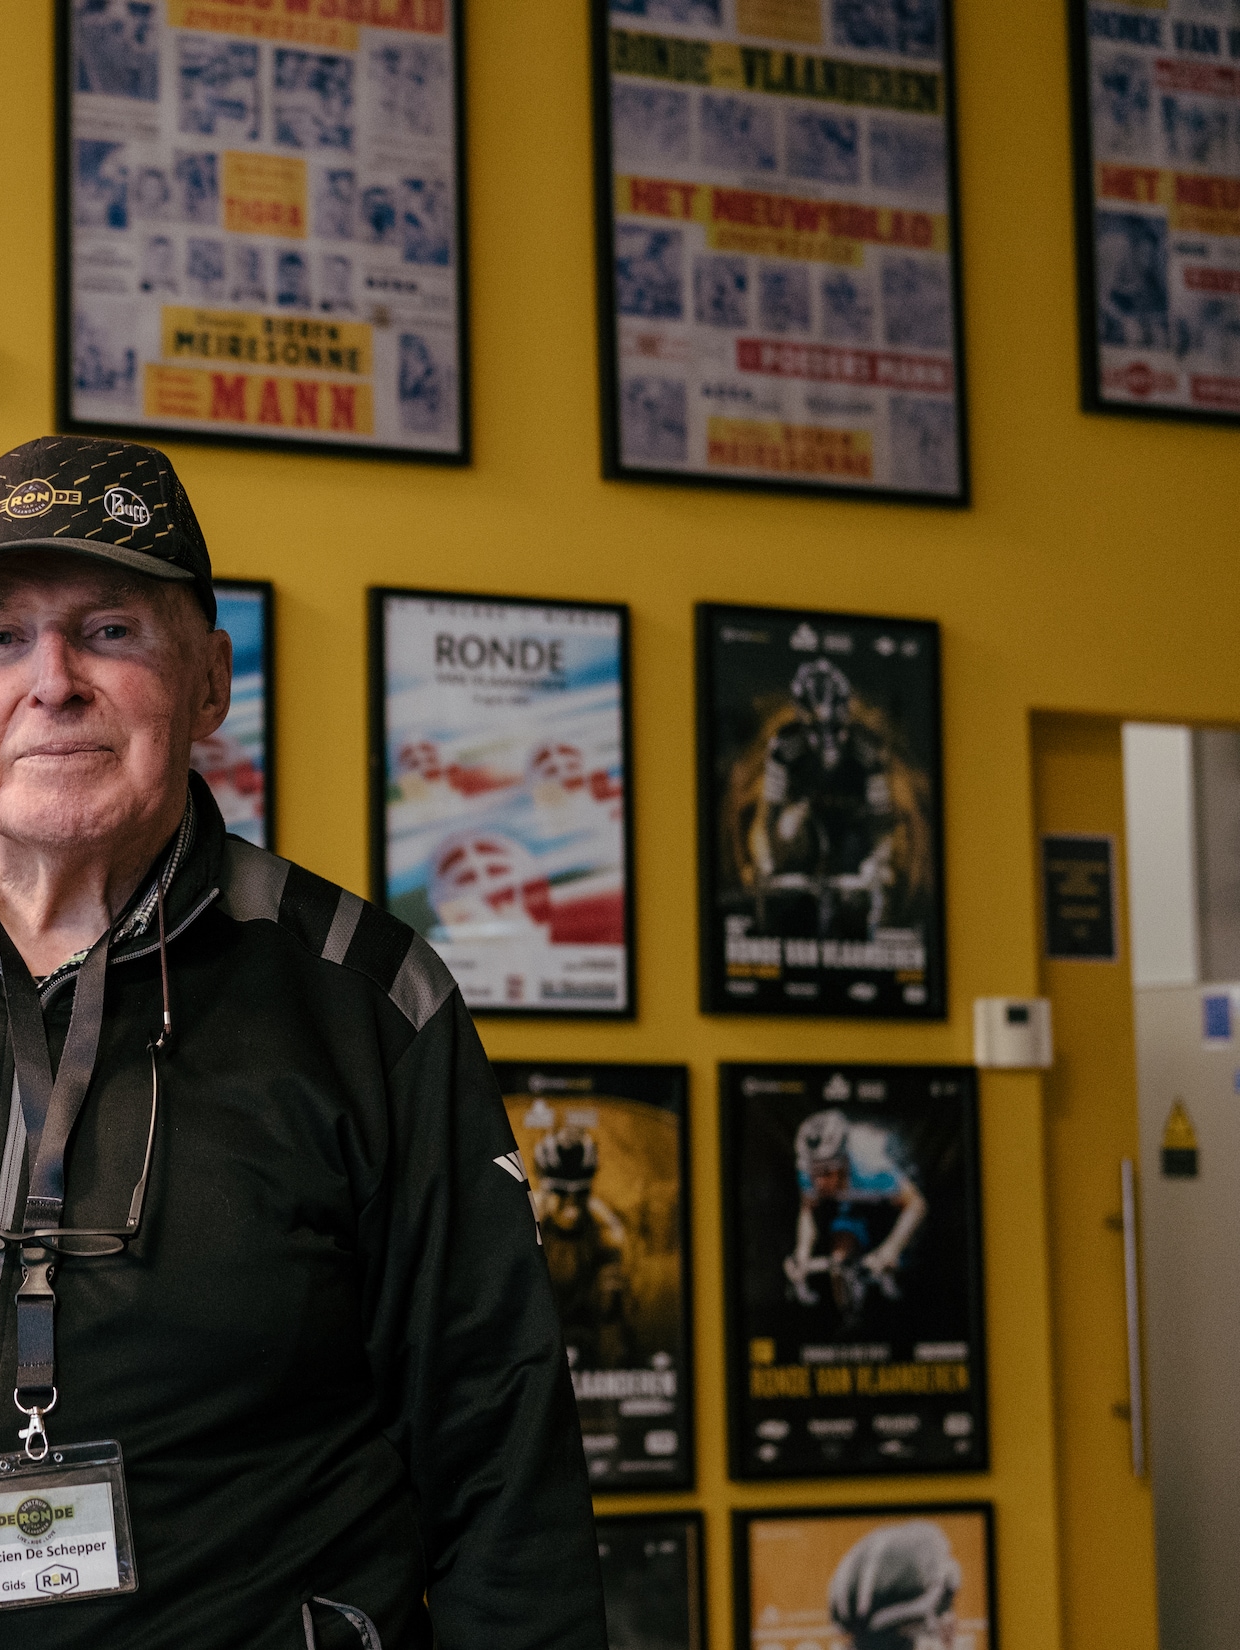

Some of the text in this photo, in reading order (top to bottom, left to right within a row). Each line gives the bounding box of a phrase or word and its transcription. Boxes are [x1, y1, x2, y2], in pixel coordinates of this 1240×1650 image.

[210, 373, 357, 434] MANN
[110, 493, 148, 523] Buff
[435, 631, 567, 674] RONDE
[21, 1500, 47, 1512] CENTRUM
[26, 1548, 43, 1560] De
[46, 1541, 107, 1557] Schepper
[2, 1580, 26, 1591] Gids
